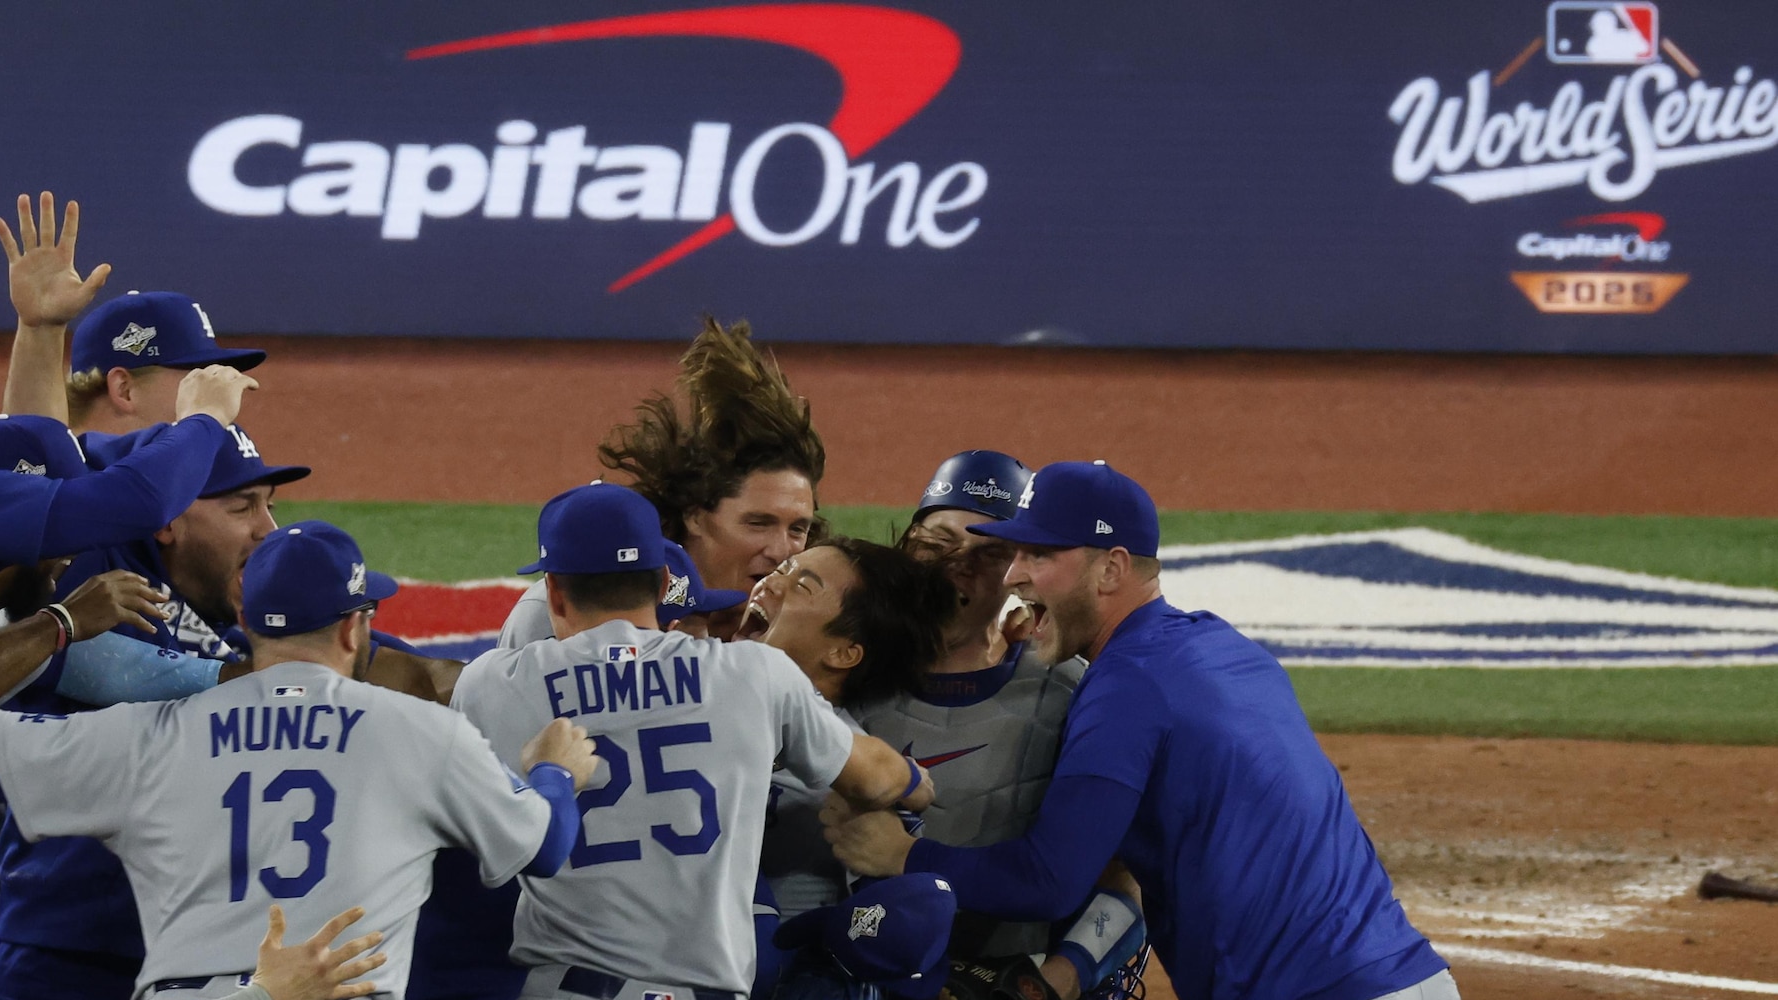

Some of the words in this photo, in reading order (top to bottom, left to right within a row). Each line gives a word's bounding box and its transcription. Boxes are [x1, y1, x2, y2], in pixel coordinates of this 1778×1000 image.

[1388, 69, 1627, 185] World
[1587, 62, 1778, 202] Serie
[186, 113, 732, 241] Capital
[729, 121, 989, 249] One
[1517, 232, 1621, 260] Capital
[1543, 280, 1655, 304] 2025
[147, 345, 160, 356] 51
[226, 425, 260, 459] LA
[963, 481, 993, 497] World
[544, 656, 703, 719] EDMAN
[210, 704, 366, 759] MUNCY
[569, 722, 722, 870] 25
[222, 769, 337, 903] 13
